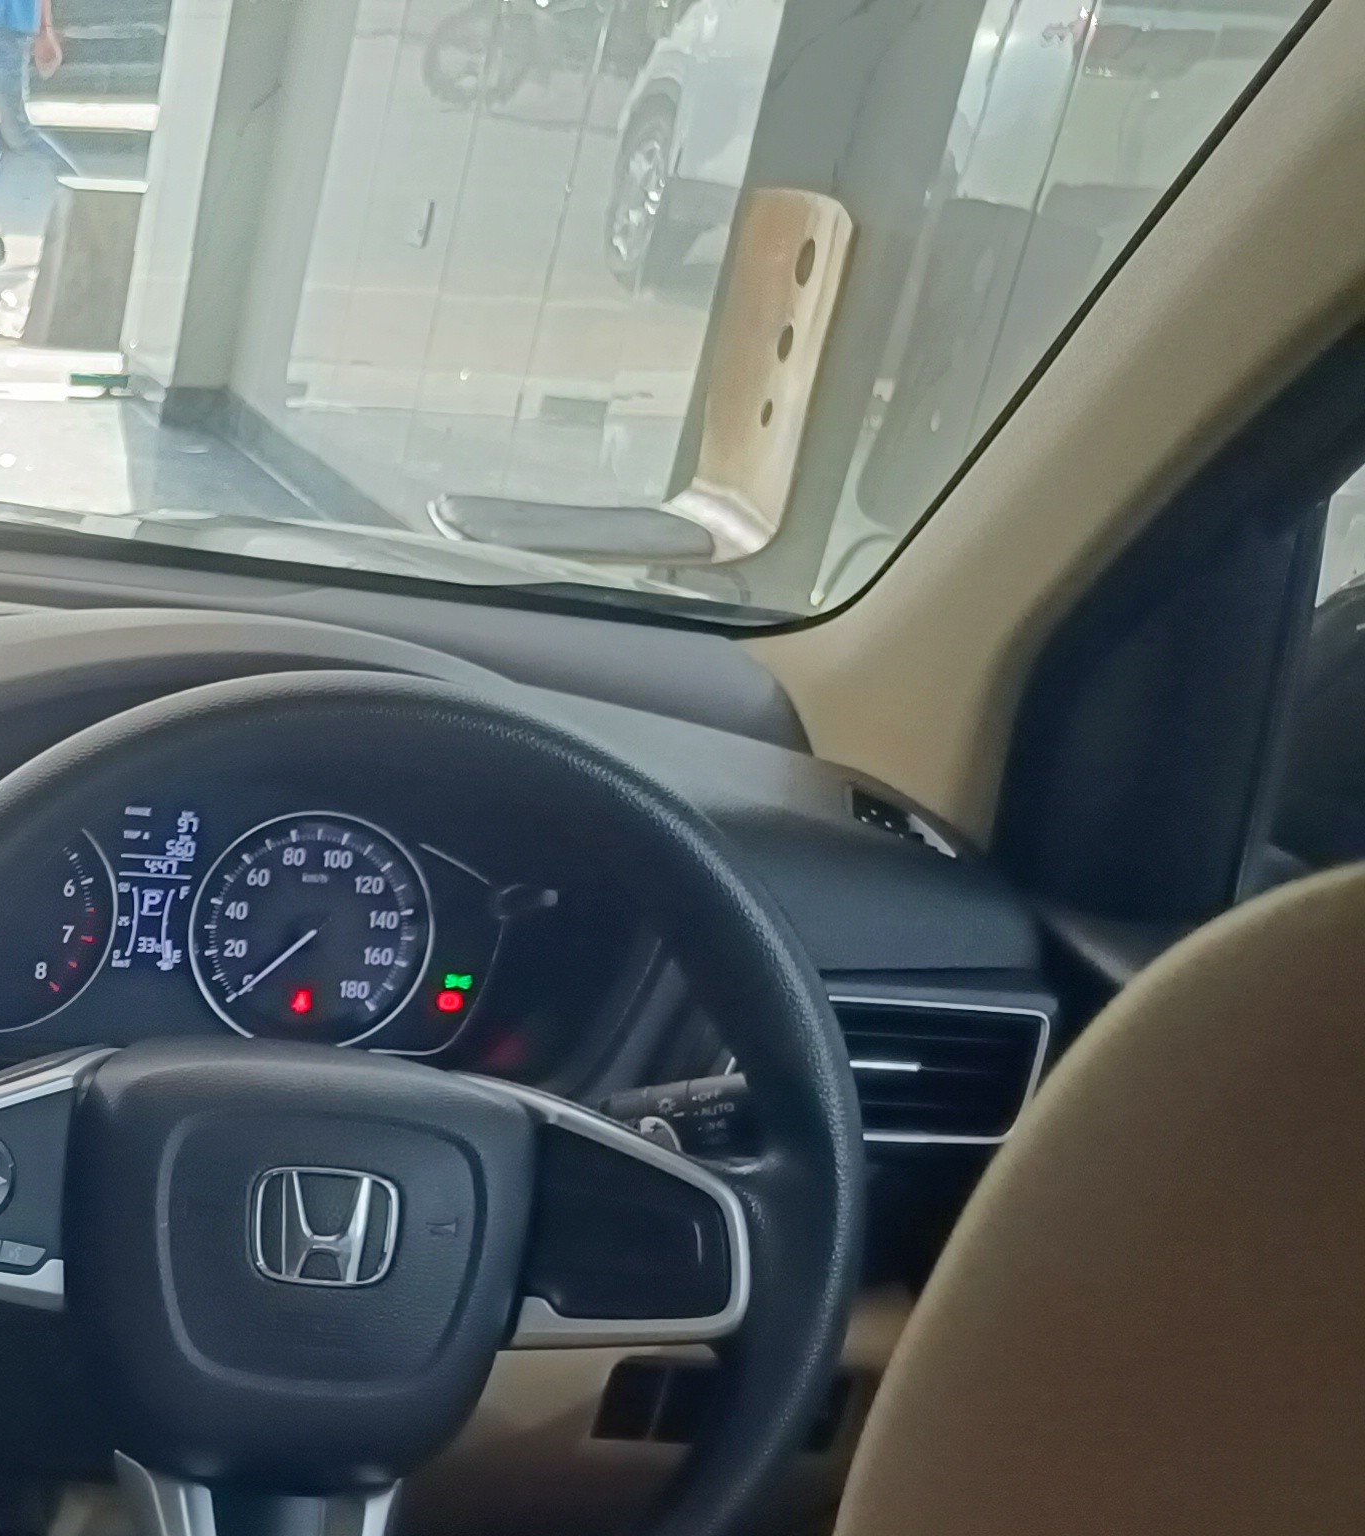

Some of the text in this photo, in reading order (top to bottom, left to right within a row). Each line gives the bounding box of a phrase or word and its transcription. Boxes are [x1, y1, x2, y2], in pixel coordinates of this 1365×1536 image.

[177, 817, 200, 833] 97
[165, 840, 197, 858] 560
[282, 847, 307, 867] 80
[323, 850, 353, 870] 100
[247, 868, 271, 887] 60
[354, 875, 385, 895] 120
[63, 879, 76, 897] 6
[143, 890, 162, 914] P
[224, 901, 249, 920] 40
[369, 910, 399, 930] 140
[62, 925, 75, 943] 7
[223, 939, 248, 958] 20
[364, 947, 394, 966] 160
[34, 961, 48, 980] 8
[340, 980, 370, 999] 180
